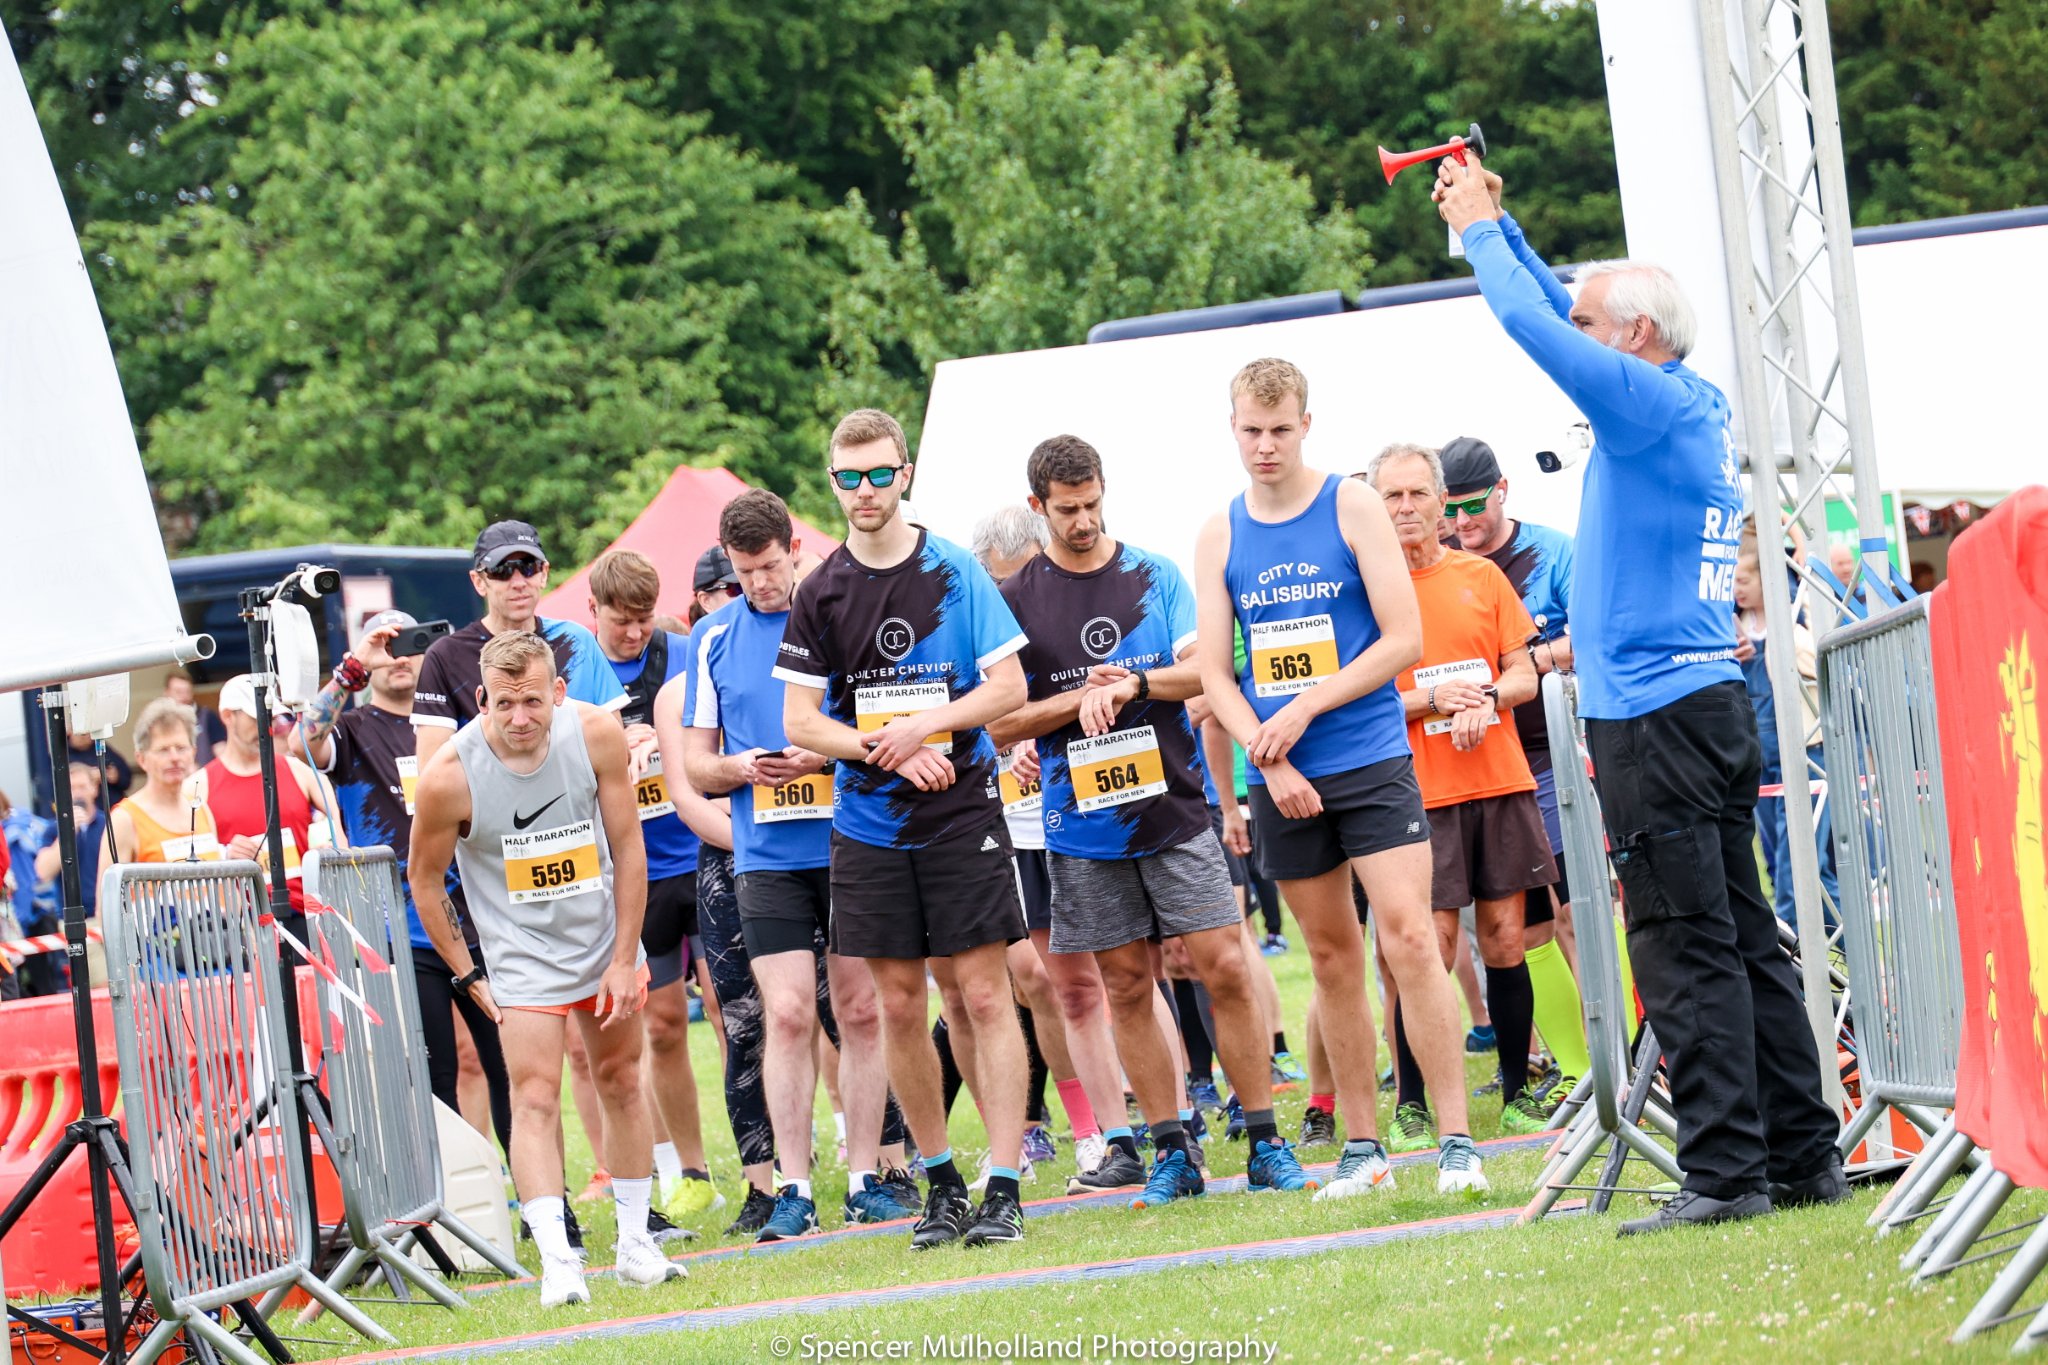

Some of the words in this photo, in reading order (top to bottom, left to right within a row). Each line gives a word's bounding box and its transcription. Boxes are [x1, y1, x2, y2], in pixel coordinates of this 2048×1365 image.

[1703, 506, 1742, 540] RAC
[1258, 562, 1294, 585] CITY
[1297, 562, 1320, 577] OF
[1240, 581, 1344, 610] SALISBURY
[1252, 625, 1269, 635] HALF
[1271, 618, 1329, 632] MARATHON
[847, 664, 895, 684] QUILTER
[899, 662, 953, 675] CHEVIOT
[1270, 653, 1313, 681] 563
[1417, 668, 1441, 679] HALF
[857, 690, 882, 700] HALF
[885, 686, 945, 697] MARATHON
[1069, 742, 1092, 753] HALF
[1094, 729, 1152, 747] MARATHON
[1095, 763, 1140, 793] 564
[637, 783, 662, 806] 45
[774, 782, 815, 807] 560
[1021, 799, 1034, 807] RACE
[1098, 796, 1114, 804] RACE
[642, 807, 654, 815] FOR
[505, 836, 531, 846] HALF
[534, 823, 590, 843] MARATHON
[531, 859, 576, 888] 559
[566, 884, 581, 892] MEN
